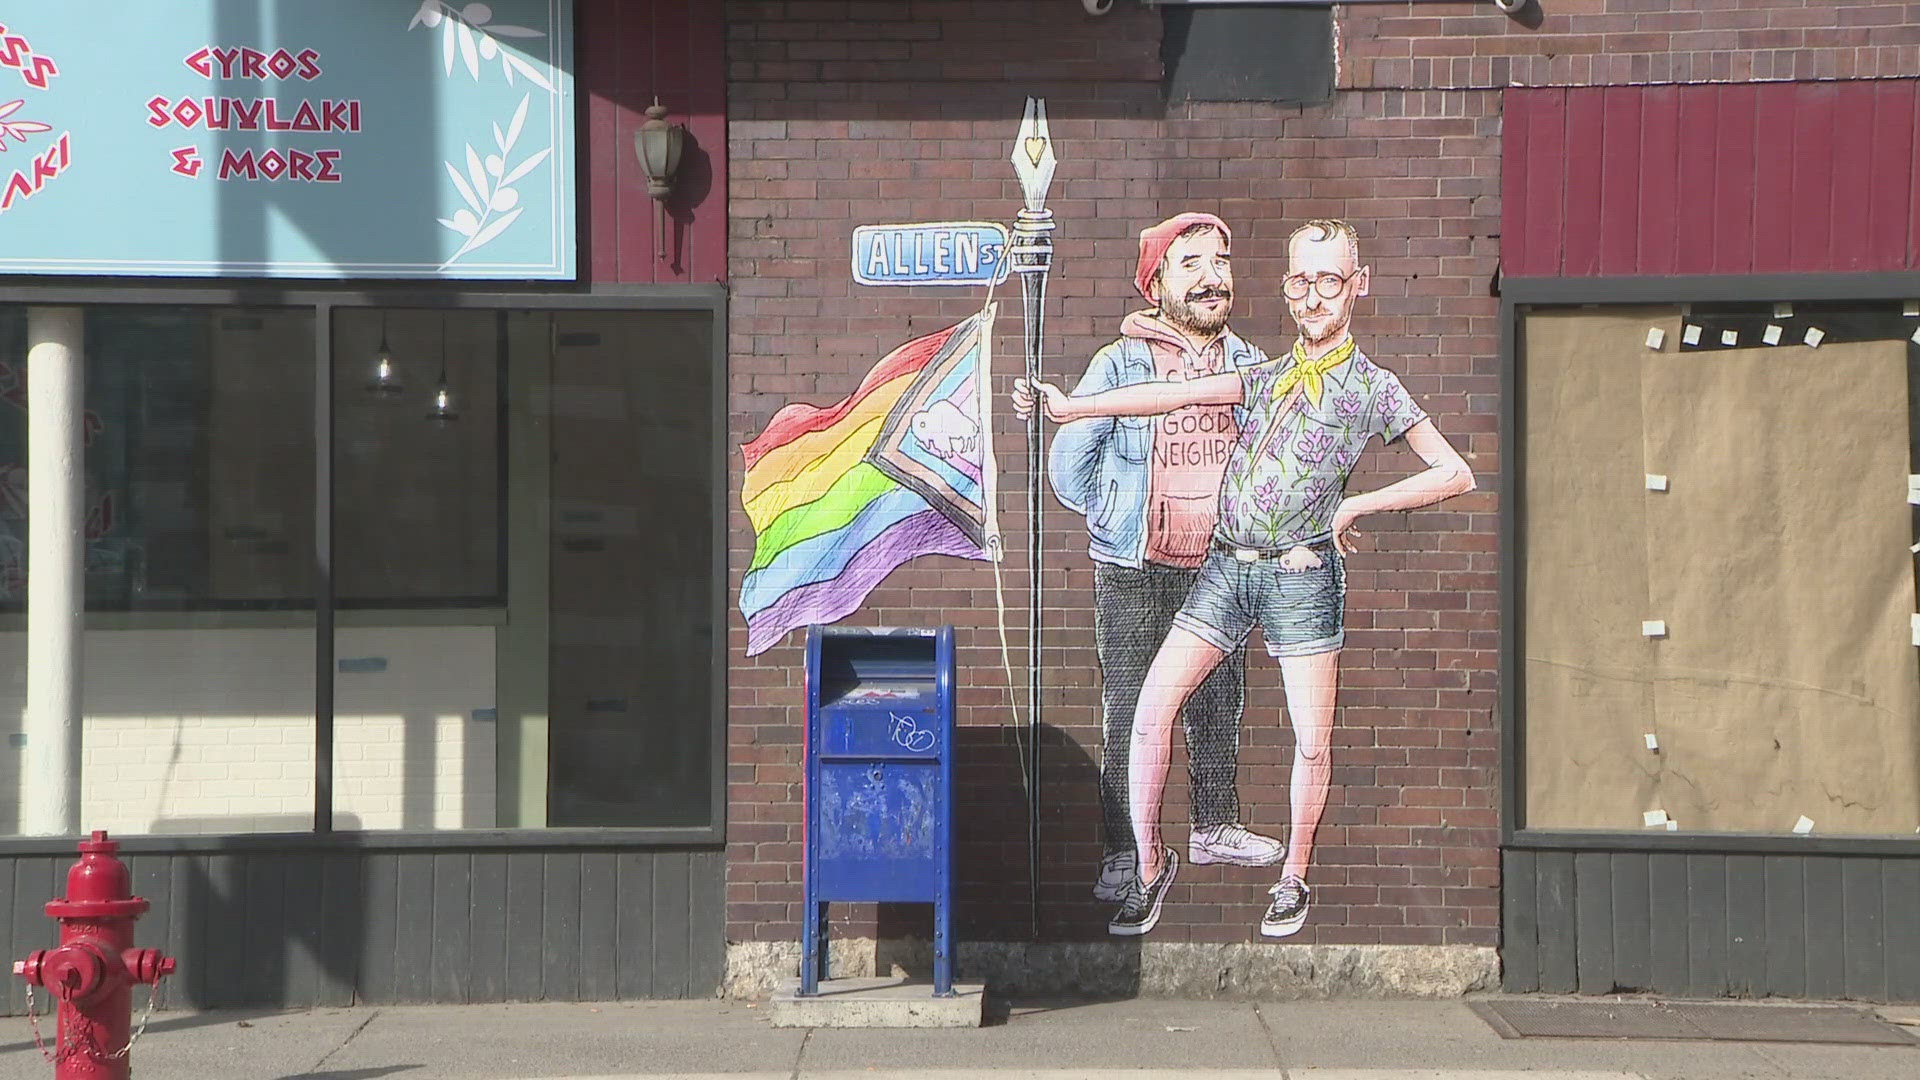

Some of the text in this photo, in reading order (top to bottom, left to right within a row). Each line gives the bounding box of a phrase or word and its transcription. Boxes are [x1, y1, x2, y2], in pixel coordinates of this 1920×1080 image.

[184, 45, 322, 81] GYROS
[146, 96, 361, 132] SOUVLAKI
[170, 145, 342, 182] & MORE
[866, 232, 979, 275] ALLEN
[1163, 412, 1230, 435] GOOD
